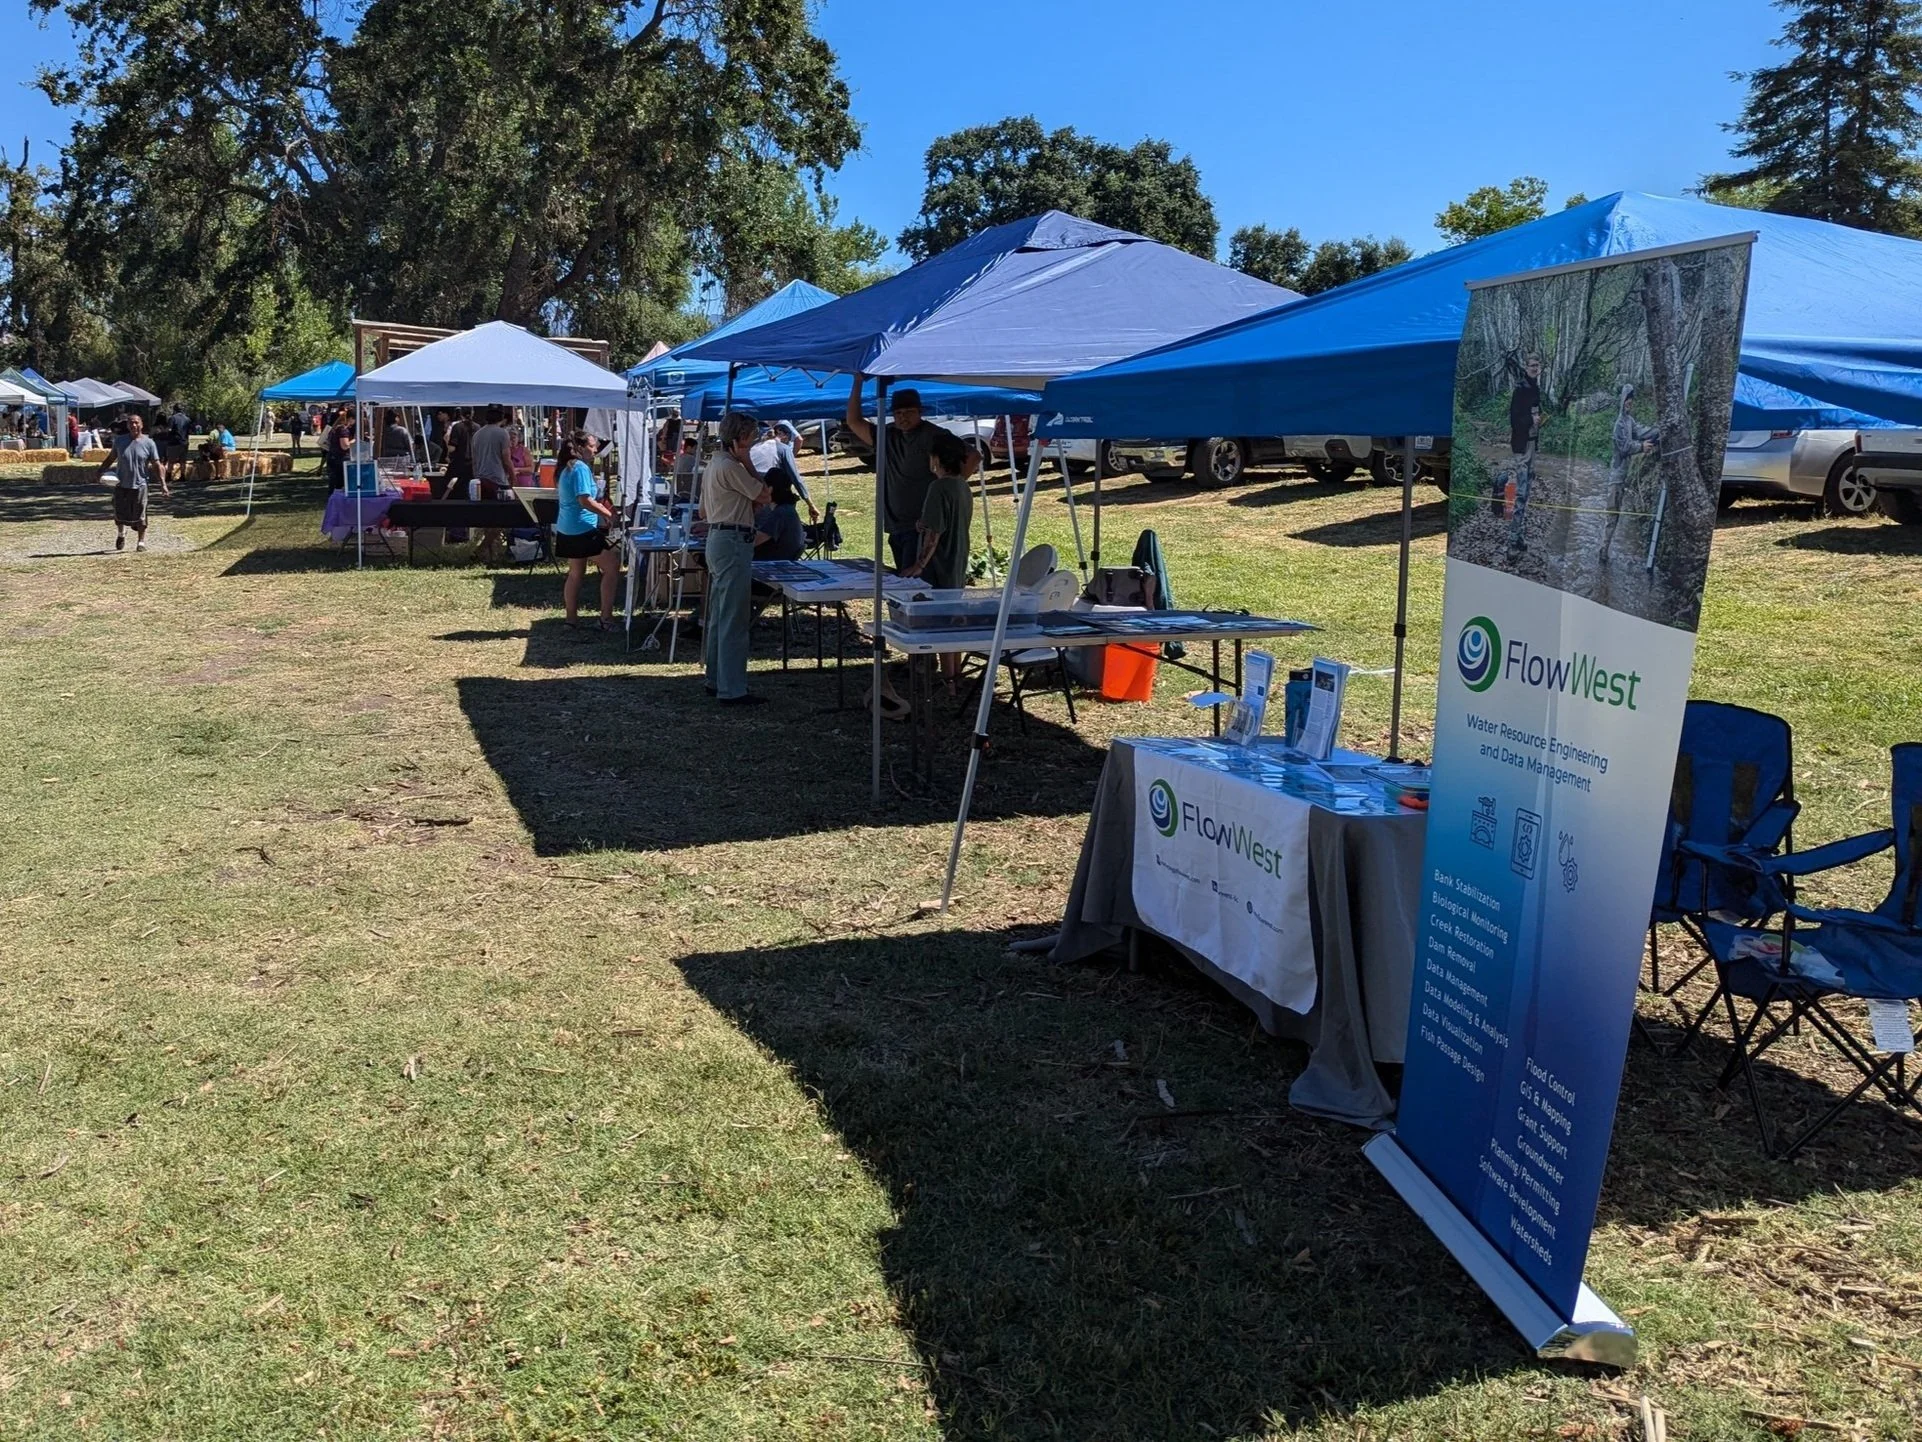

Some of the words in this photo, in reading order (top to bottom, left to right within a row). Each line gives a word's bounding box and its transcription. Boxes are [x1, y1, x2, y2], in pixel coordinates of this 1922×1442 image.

[1505, 640, 1641, 710] FlowWest
[1467, 713, 1498, 735] Water
[1500, 723, 1546, 749] Resource
[1550, 737, 1608, 774] Engineering
[1480, 743, 1499, 760] and
[1501, 748, 1524, 768] Data
[1526, 757, 1591, 792] Management
[1183, 801, 1282, 879] FlowWest
[1434, 869, 1453, 887] Bank
[1455, 877, 1500, 912] Stabilization
[1430, 914, 1452, 934] Creek
[1455, 925, 1494, 959] Restoration
[1432, 891, 1469, 919] Biological
[1471, 910, 1508, 945] Monitoring
[1428, 935, 1445, 954] Dam
[1448, 945, 1476, 974] Removal
[1426, 958, 1444, 978] Data
[1446, 968, 1488, 1007] Management
[1422, 1003, 1439, 1023] Data
[1441, 1014, 1483, 1055] Visualization
[1424, 980, 1442, 1001] Data
[1443, 991, 1473, 1026] Modeling
[1474, 1013, 1480, 1027] &
[1481, 1019, 1509, 1048] Analysis
[1421, 1025, 1435, 1045] Fish
[1436, 1036, 1462, 1065] Passage
[1462, 1055, 1485, 1083] Design
[1520, 1081, 1532, 1100] GIS
[1533, 1091, 1540, 1106] &
[1541, 1098, 1572, 1136] Mapping
[1526, 1057, 1547, 1083] Flood
[1548, 1074, 1576, 1107] Control
[1518, 1106, 1537, 1133] Grant
[1539, 1124, 1568, 1160] Support
[1490, 1137, 1561, 1216] Planning/Permitting
[1517, 1135, 1564, 1186] Groundwater
[1478, 1155, 1508, 1192] Software
[1509, 1185, 1556, 1240] Development
[1511, 1214, 1552, 1266] Watersheds
